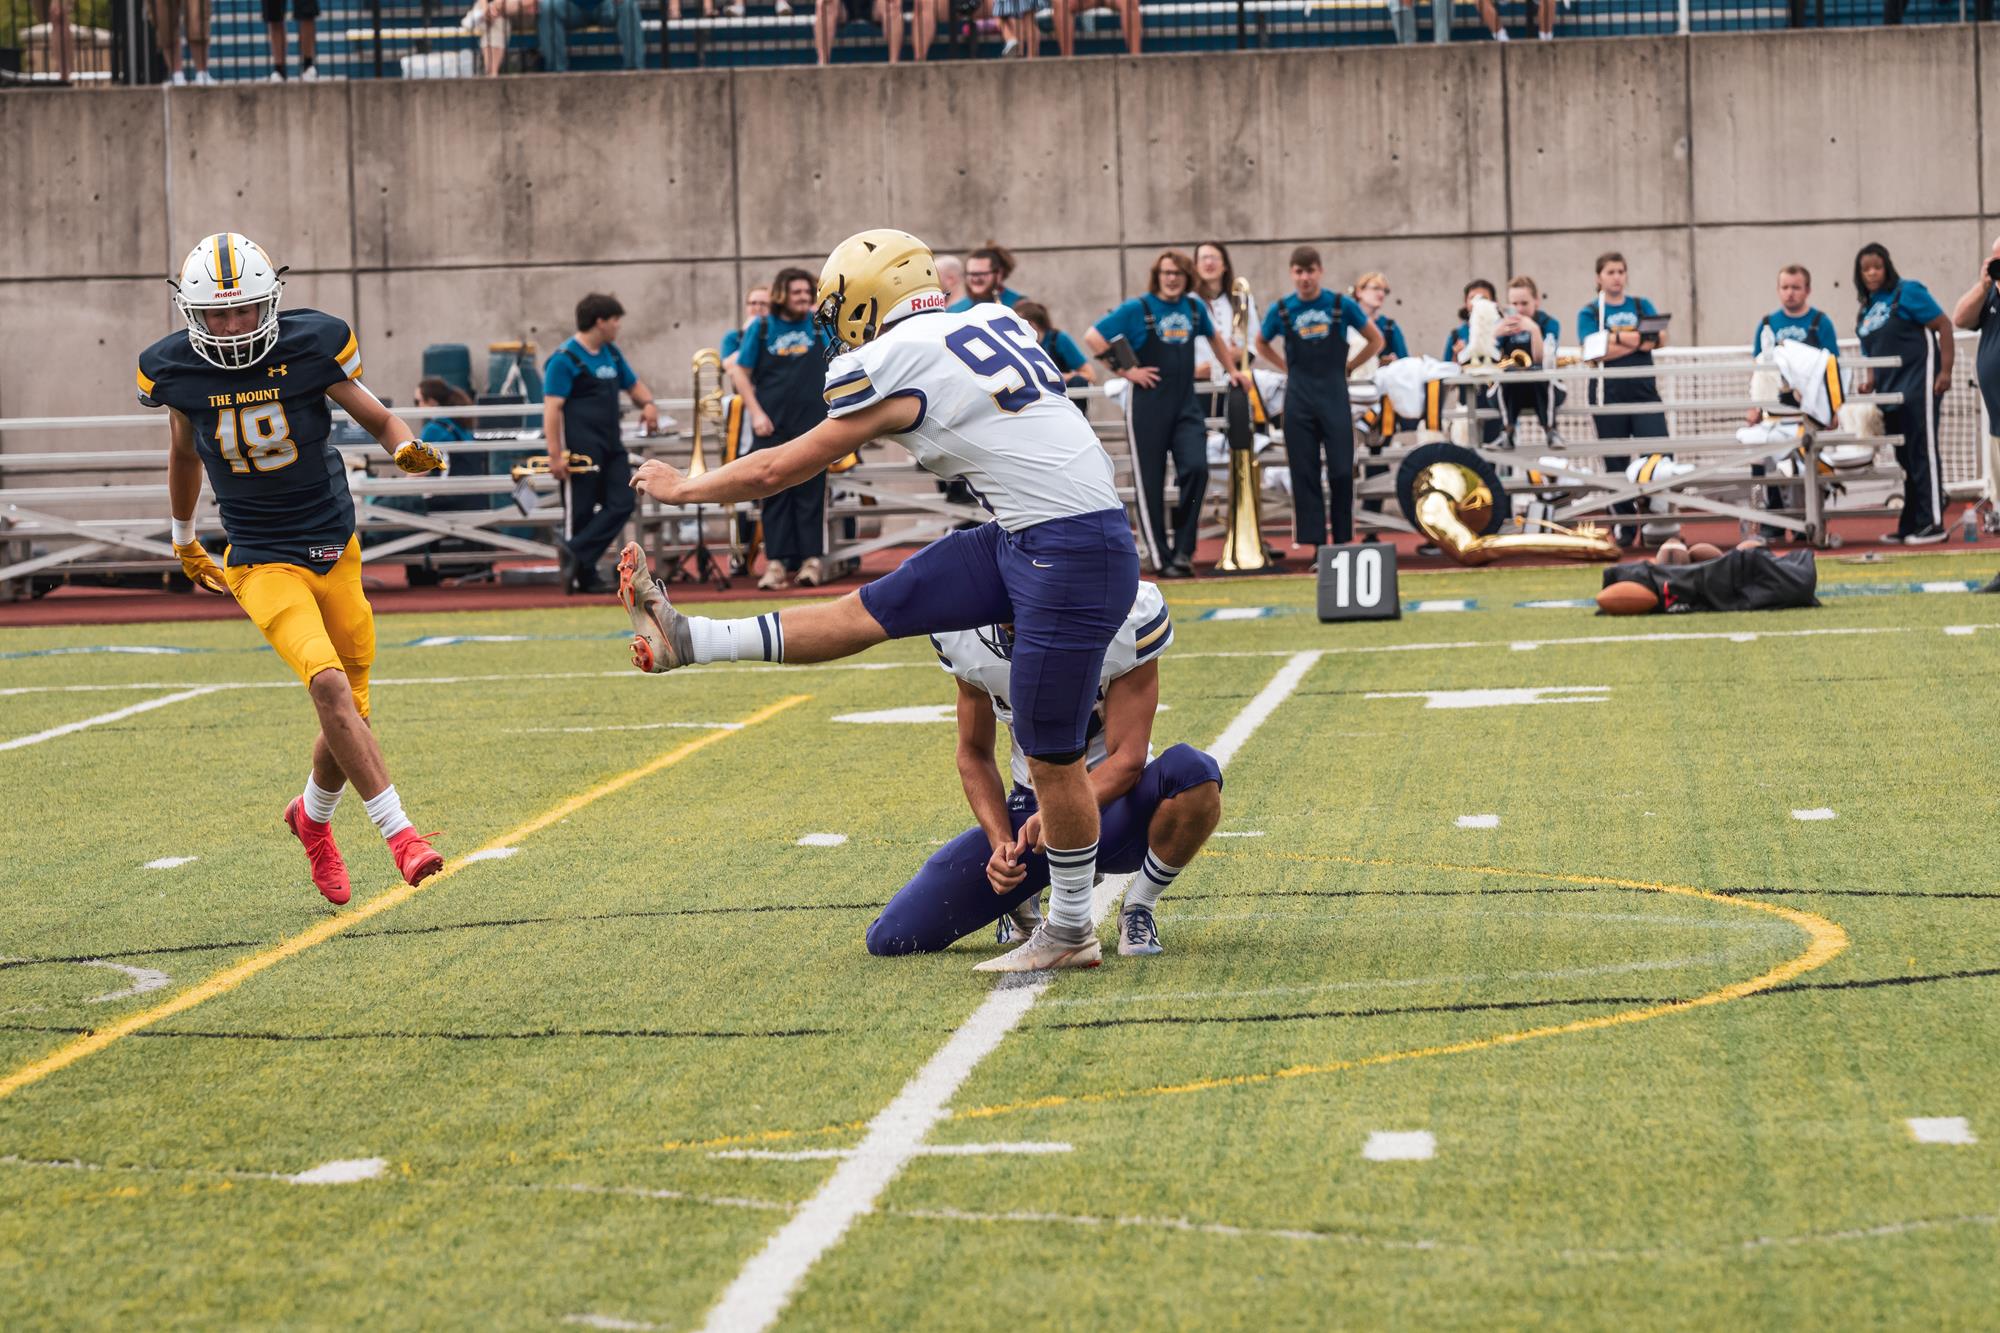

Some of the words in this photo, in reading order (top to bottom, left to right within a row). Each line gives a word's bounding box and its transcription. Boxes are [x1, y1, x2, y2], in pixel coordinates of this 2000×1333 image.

[214, 290, 242, 298] Riddell
[911, 295, 944, 311] Ridde
[945, 315, 1067, 414] 96
[208, 394, 232, 407] THE
[236, 388, 280, 404] MOUNT
[214, 400, 298, 473] 18
[1331, 548, 1382, 608] 10
